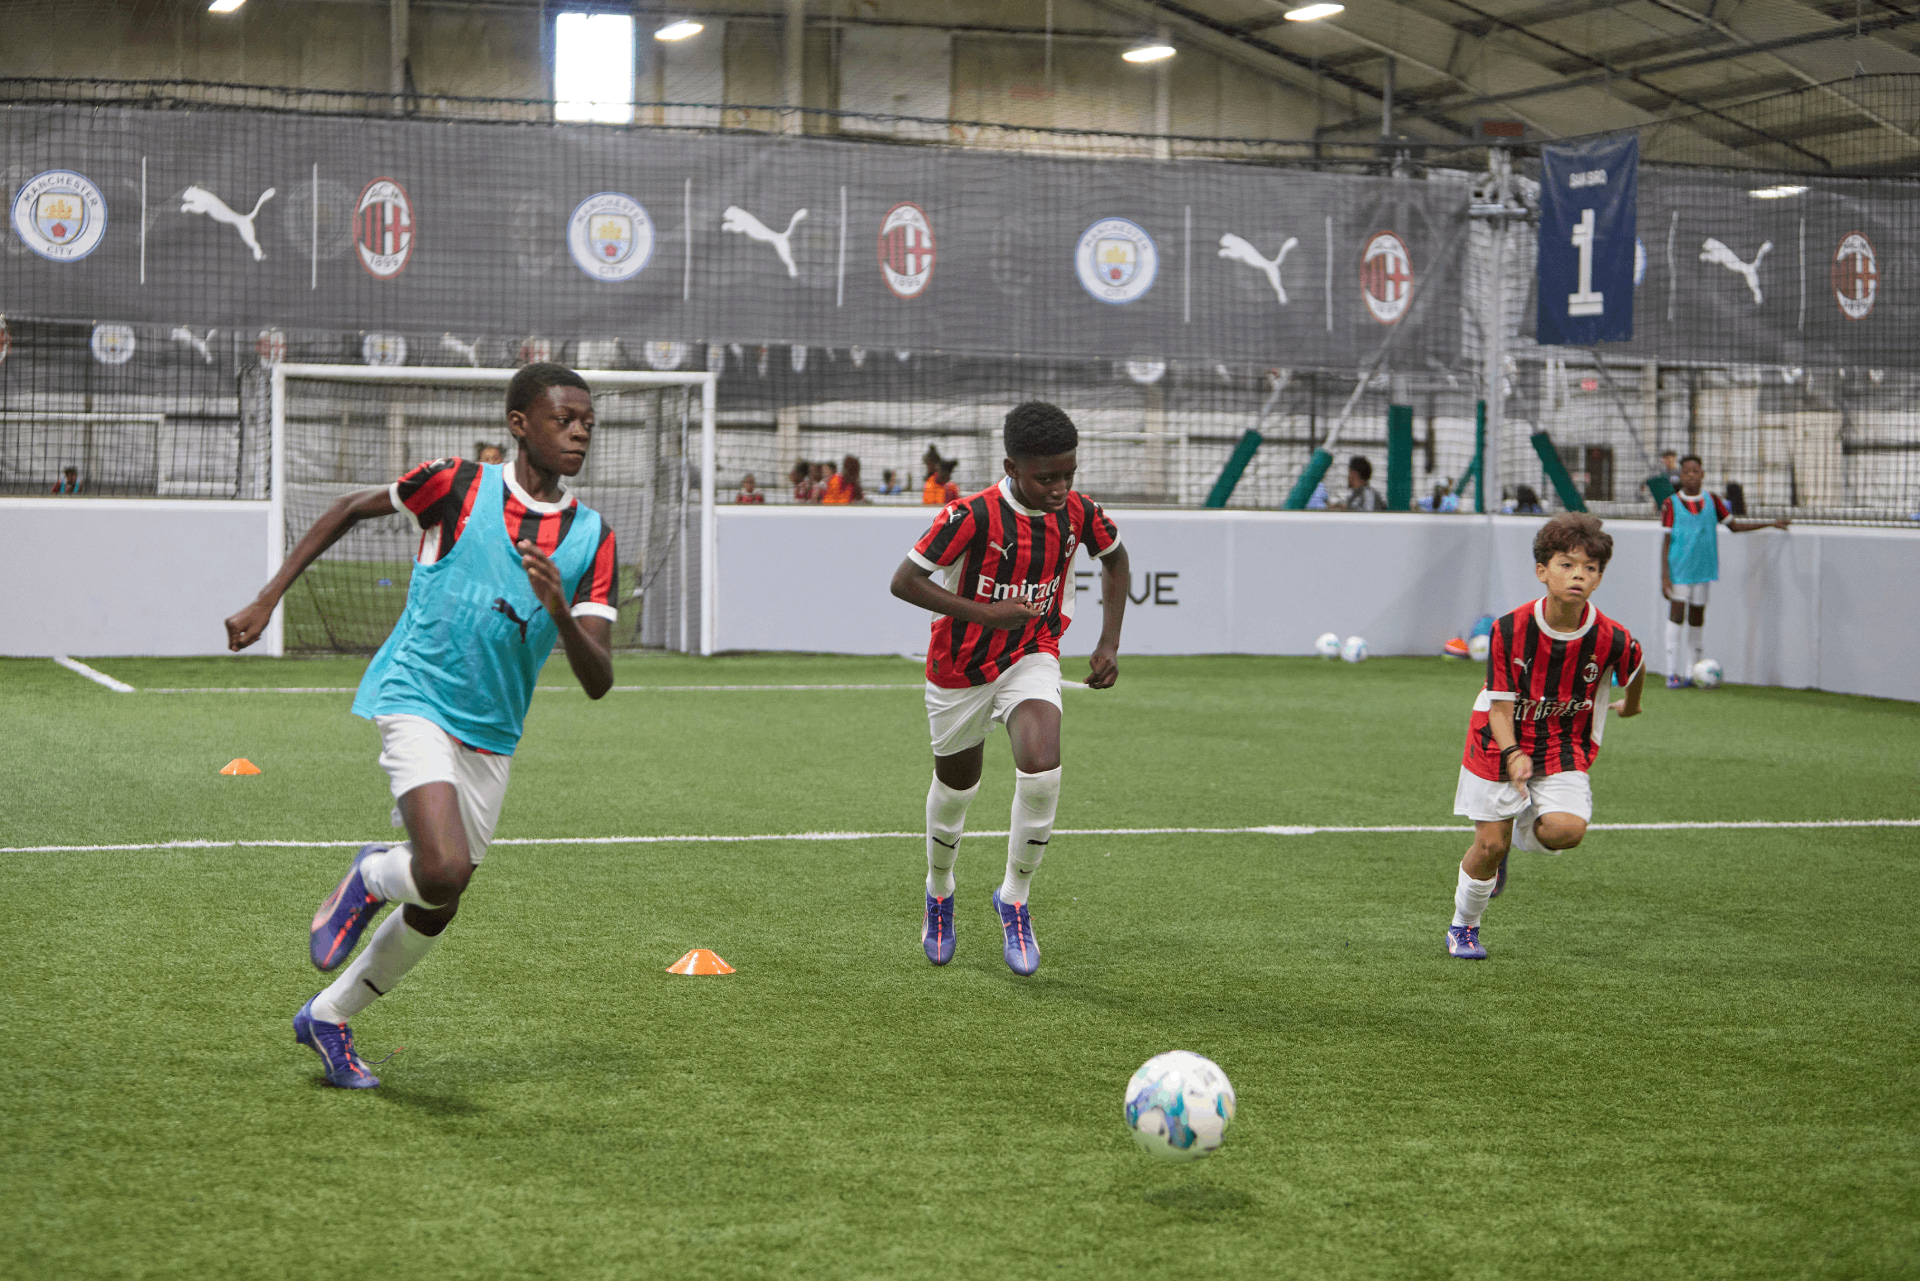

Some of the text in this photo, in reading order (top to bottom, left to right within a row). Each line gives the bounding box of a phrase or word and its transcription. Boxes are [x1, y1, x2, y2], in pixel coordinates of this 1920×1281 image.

[24, 175, 99, 208] MANCHESTER
[46, 246, 74, 256] CITY
[1568, 208, 1604, 316] 1
[598, 266, 625, 275] CITY
[976, 574, 1061, 602] Emirate
[1074, 571, 1179, 605] FVE
[1515, 693, 1593, 711] mirates
